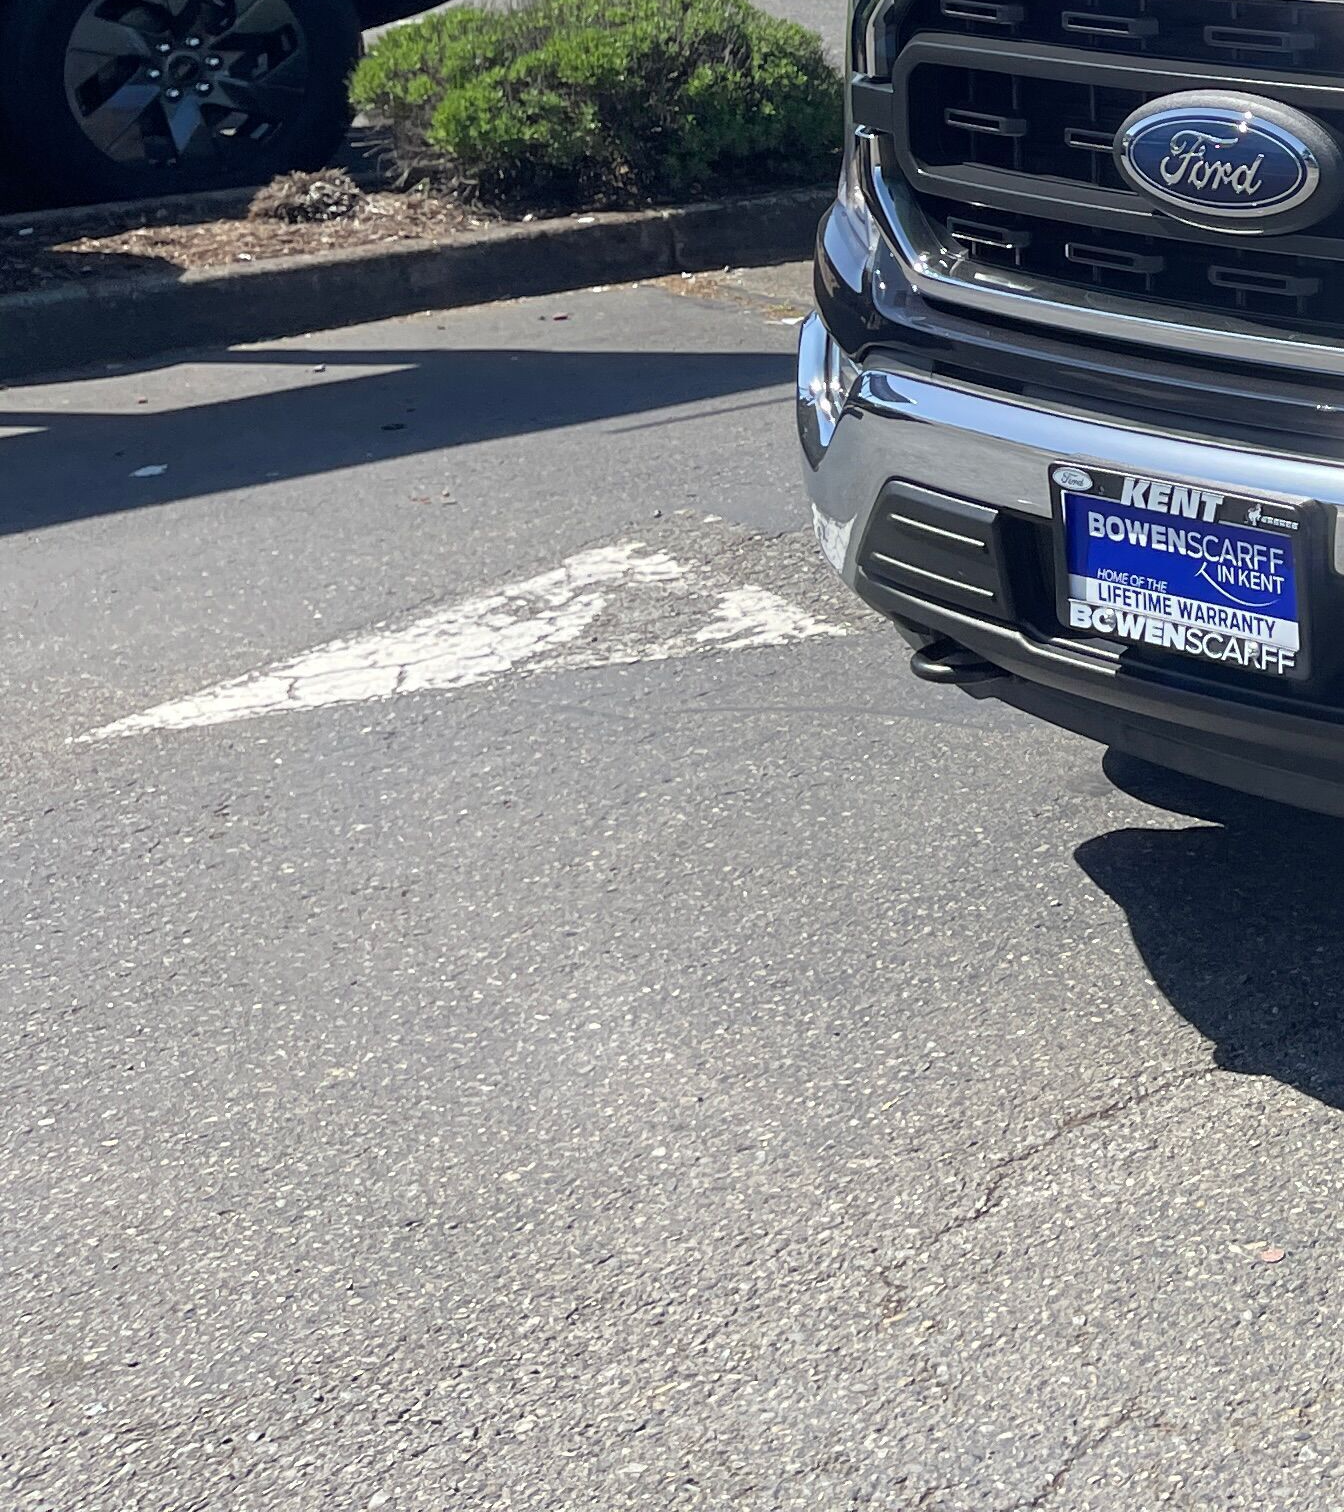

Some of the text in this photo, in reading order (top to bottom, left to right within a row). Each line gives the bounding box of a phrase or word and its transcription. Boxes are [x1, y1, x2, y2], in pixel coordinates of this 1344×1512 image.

[1160, 130, 1265, 194] Ford
[1060, 471, 1084, 487] Ford
[1120, 476, 1225, 523] KENT
[1097, 567, 1168, 594] HOME OF THE
[1217, 564, 1285, 595] IN KENT
[1097, 582, 1276, 639] LIFETIME WARRANTY
